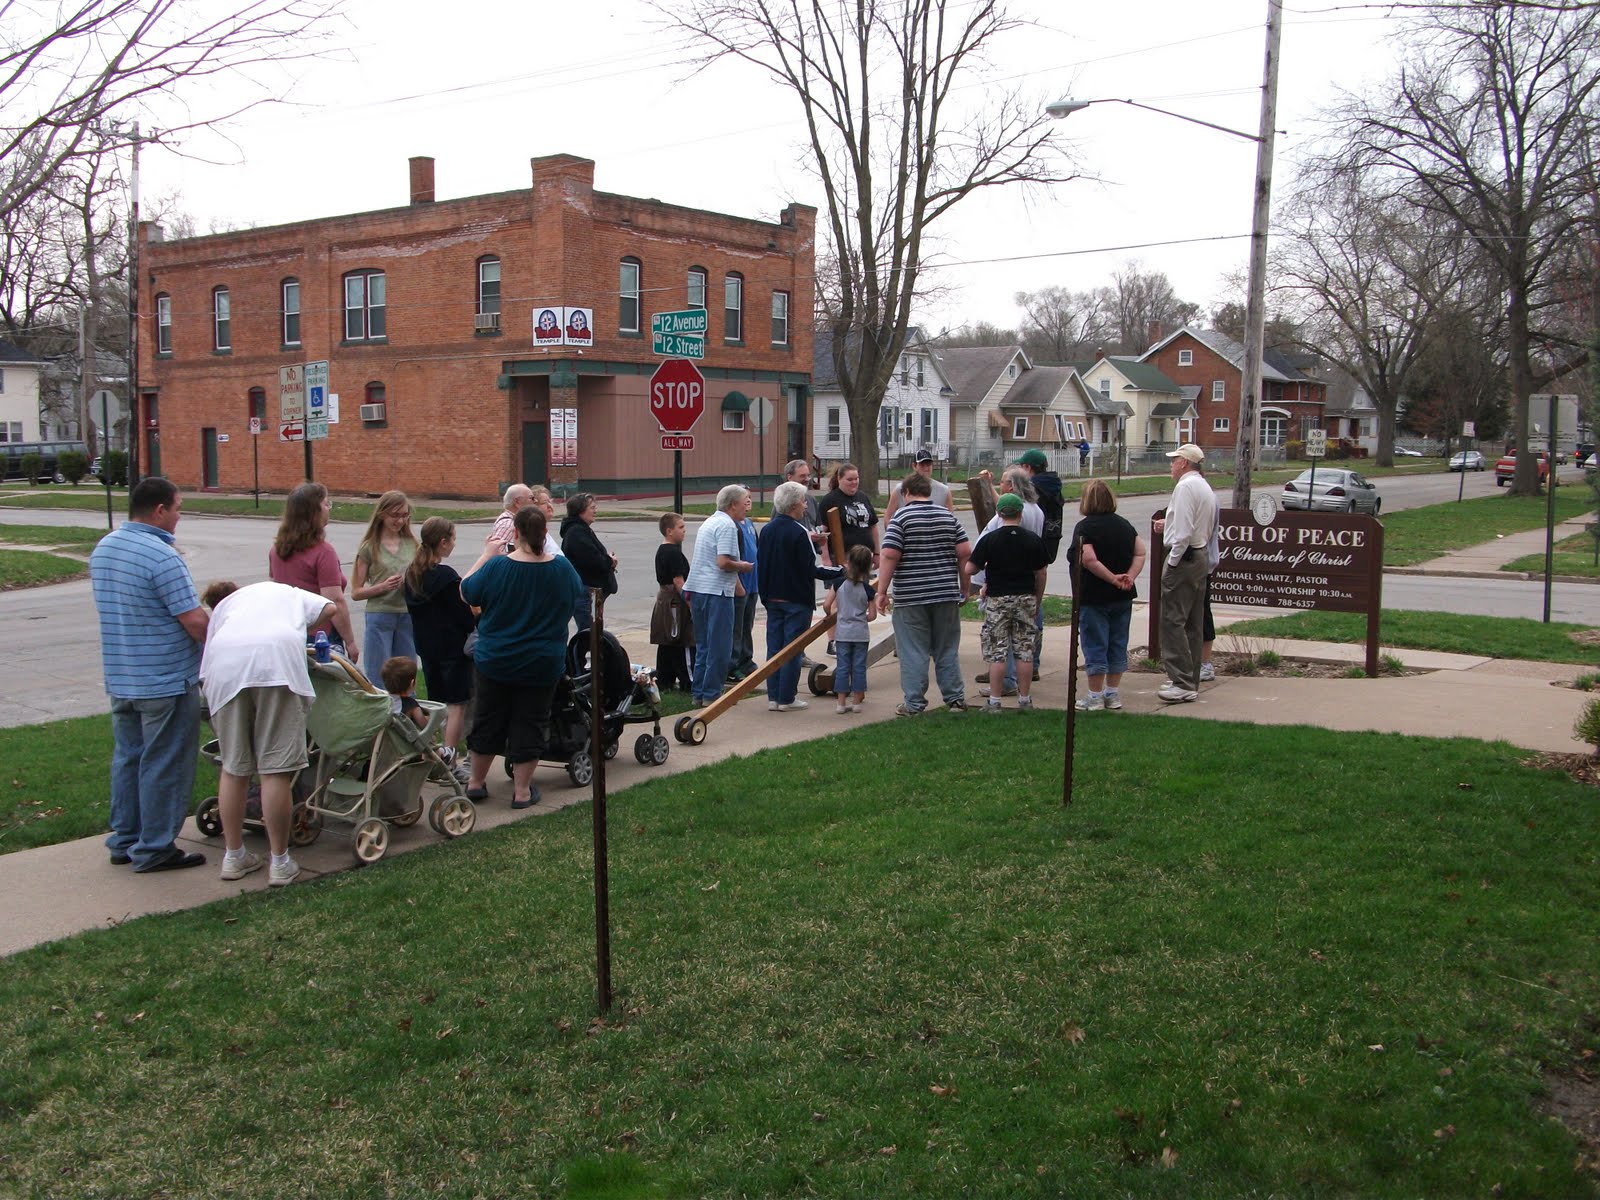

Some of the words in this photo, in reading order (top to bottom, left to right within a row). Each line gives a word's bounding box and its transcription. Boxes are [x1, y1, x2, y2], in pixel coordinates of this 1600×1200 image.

[661, 315, 671, 332] 12
[673, 314, 705, 331] Avenue
[662, 336, 673, 353] 12
[676, 336, 703, 356] Street
[286, 370, 297, 381] NO
[281, 382, 303, 393] PARKING
[653, 381, 701, 409] STOP
[663, 438, 676, 448] ALL
[678, 438, 692, 448] WAY
[1217, 525, 1255, 542] RCH
[1261, 527, 1290, 543] OF
[1297, 528, 1365, 547] PEACE
[1232, 546, 1286, 564] Church
[1287, 550, 1307, 569] of
[1307, 551, 1352, 566] Christ
[1216, 571, 1253, 581] MICHAEL
[1255, 573, 1293, 584] SWARTZ,
[1295, 575, 1328, 585] PASTOR
[1210, 582, 1244, 592] SCHOOL
[1246, 584, 1263, 592] 9:00
[1277, 586, 1316, 596] WORSHIP
[1319, 589, 1340, 598] 10:30
[1210, 594, 1223, 602] ALL
[1225, 595, 1268, 605] WELCOME
[1277, 598, 1315, 608] 788-6357
